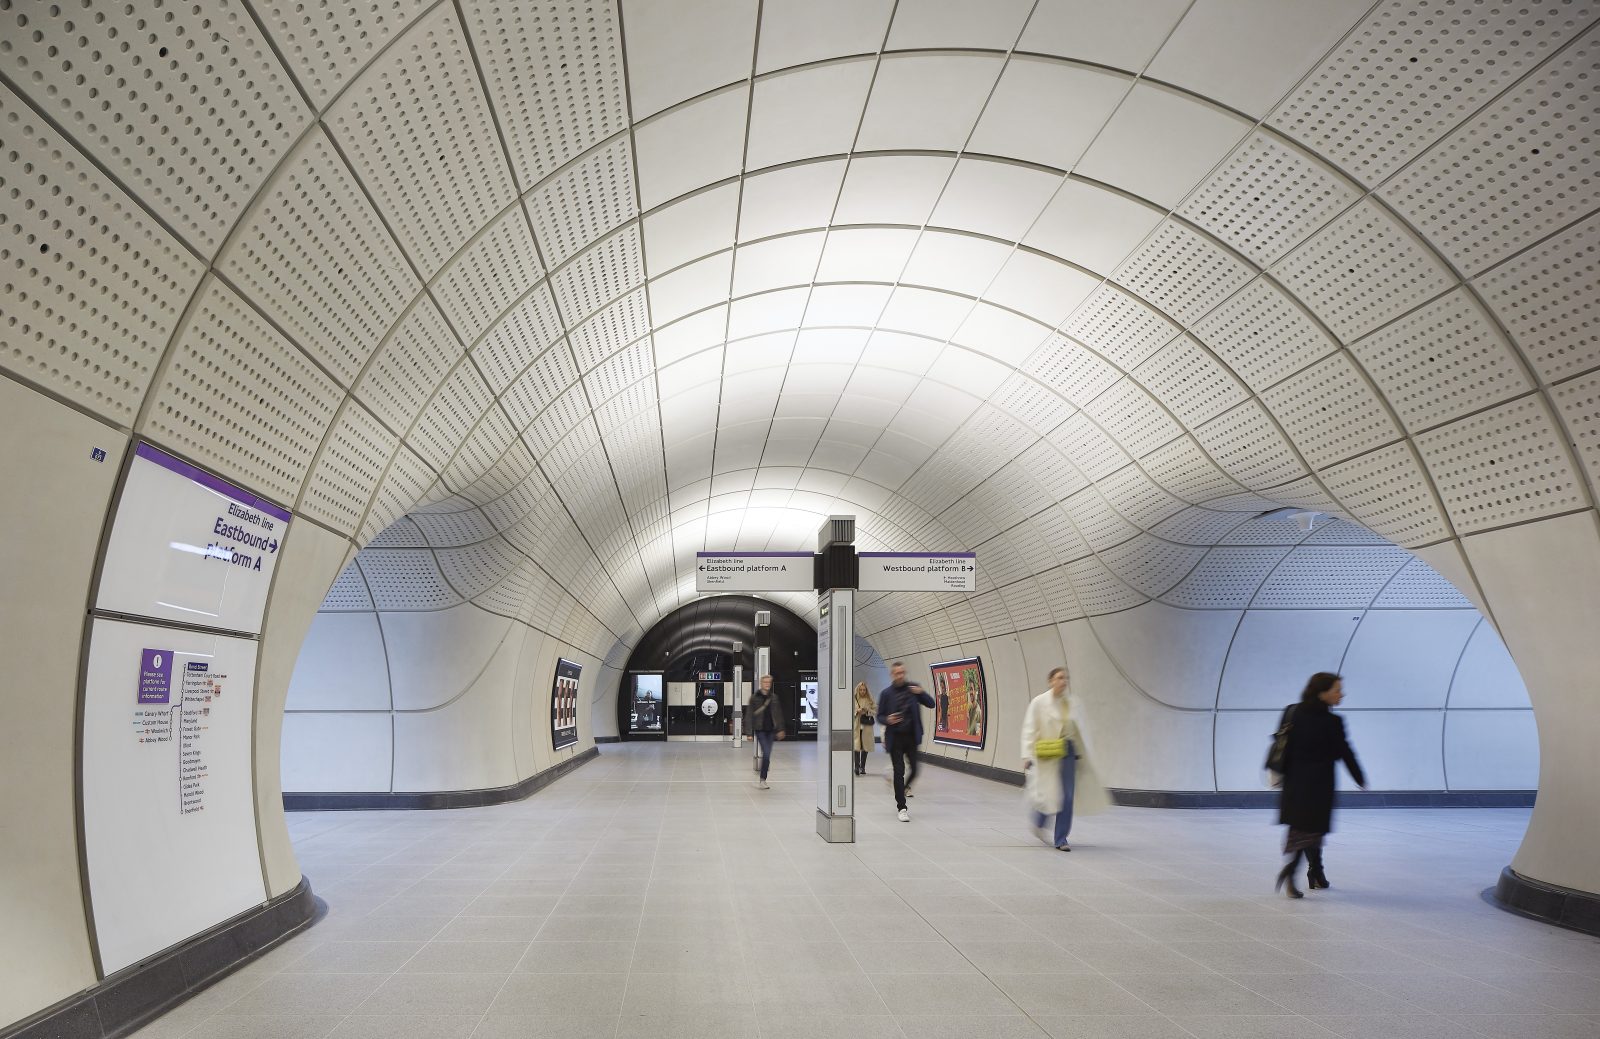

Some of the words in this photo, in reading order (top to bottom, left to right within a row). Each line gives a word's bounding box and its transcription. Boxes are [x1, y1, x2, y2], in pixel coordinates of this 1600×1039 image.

[228, 502, 261, 525] Elizabeth
[262, 517, 274, 531] line
[214, 517, 270, 551] Eastbound
[253, 556, 261, 571] A
